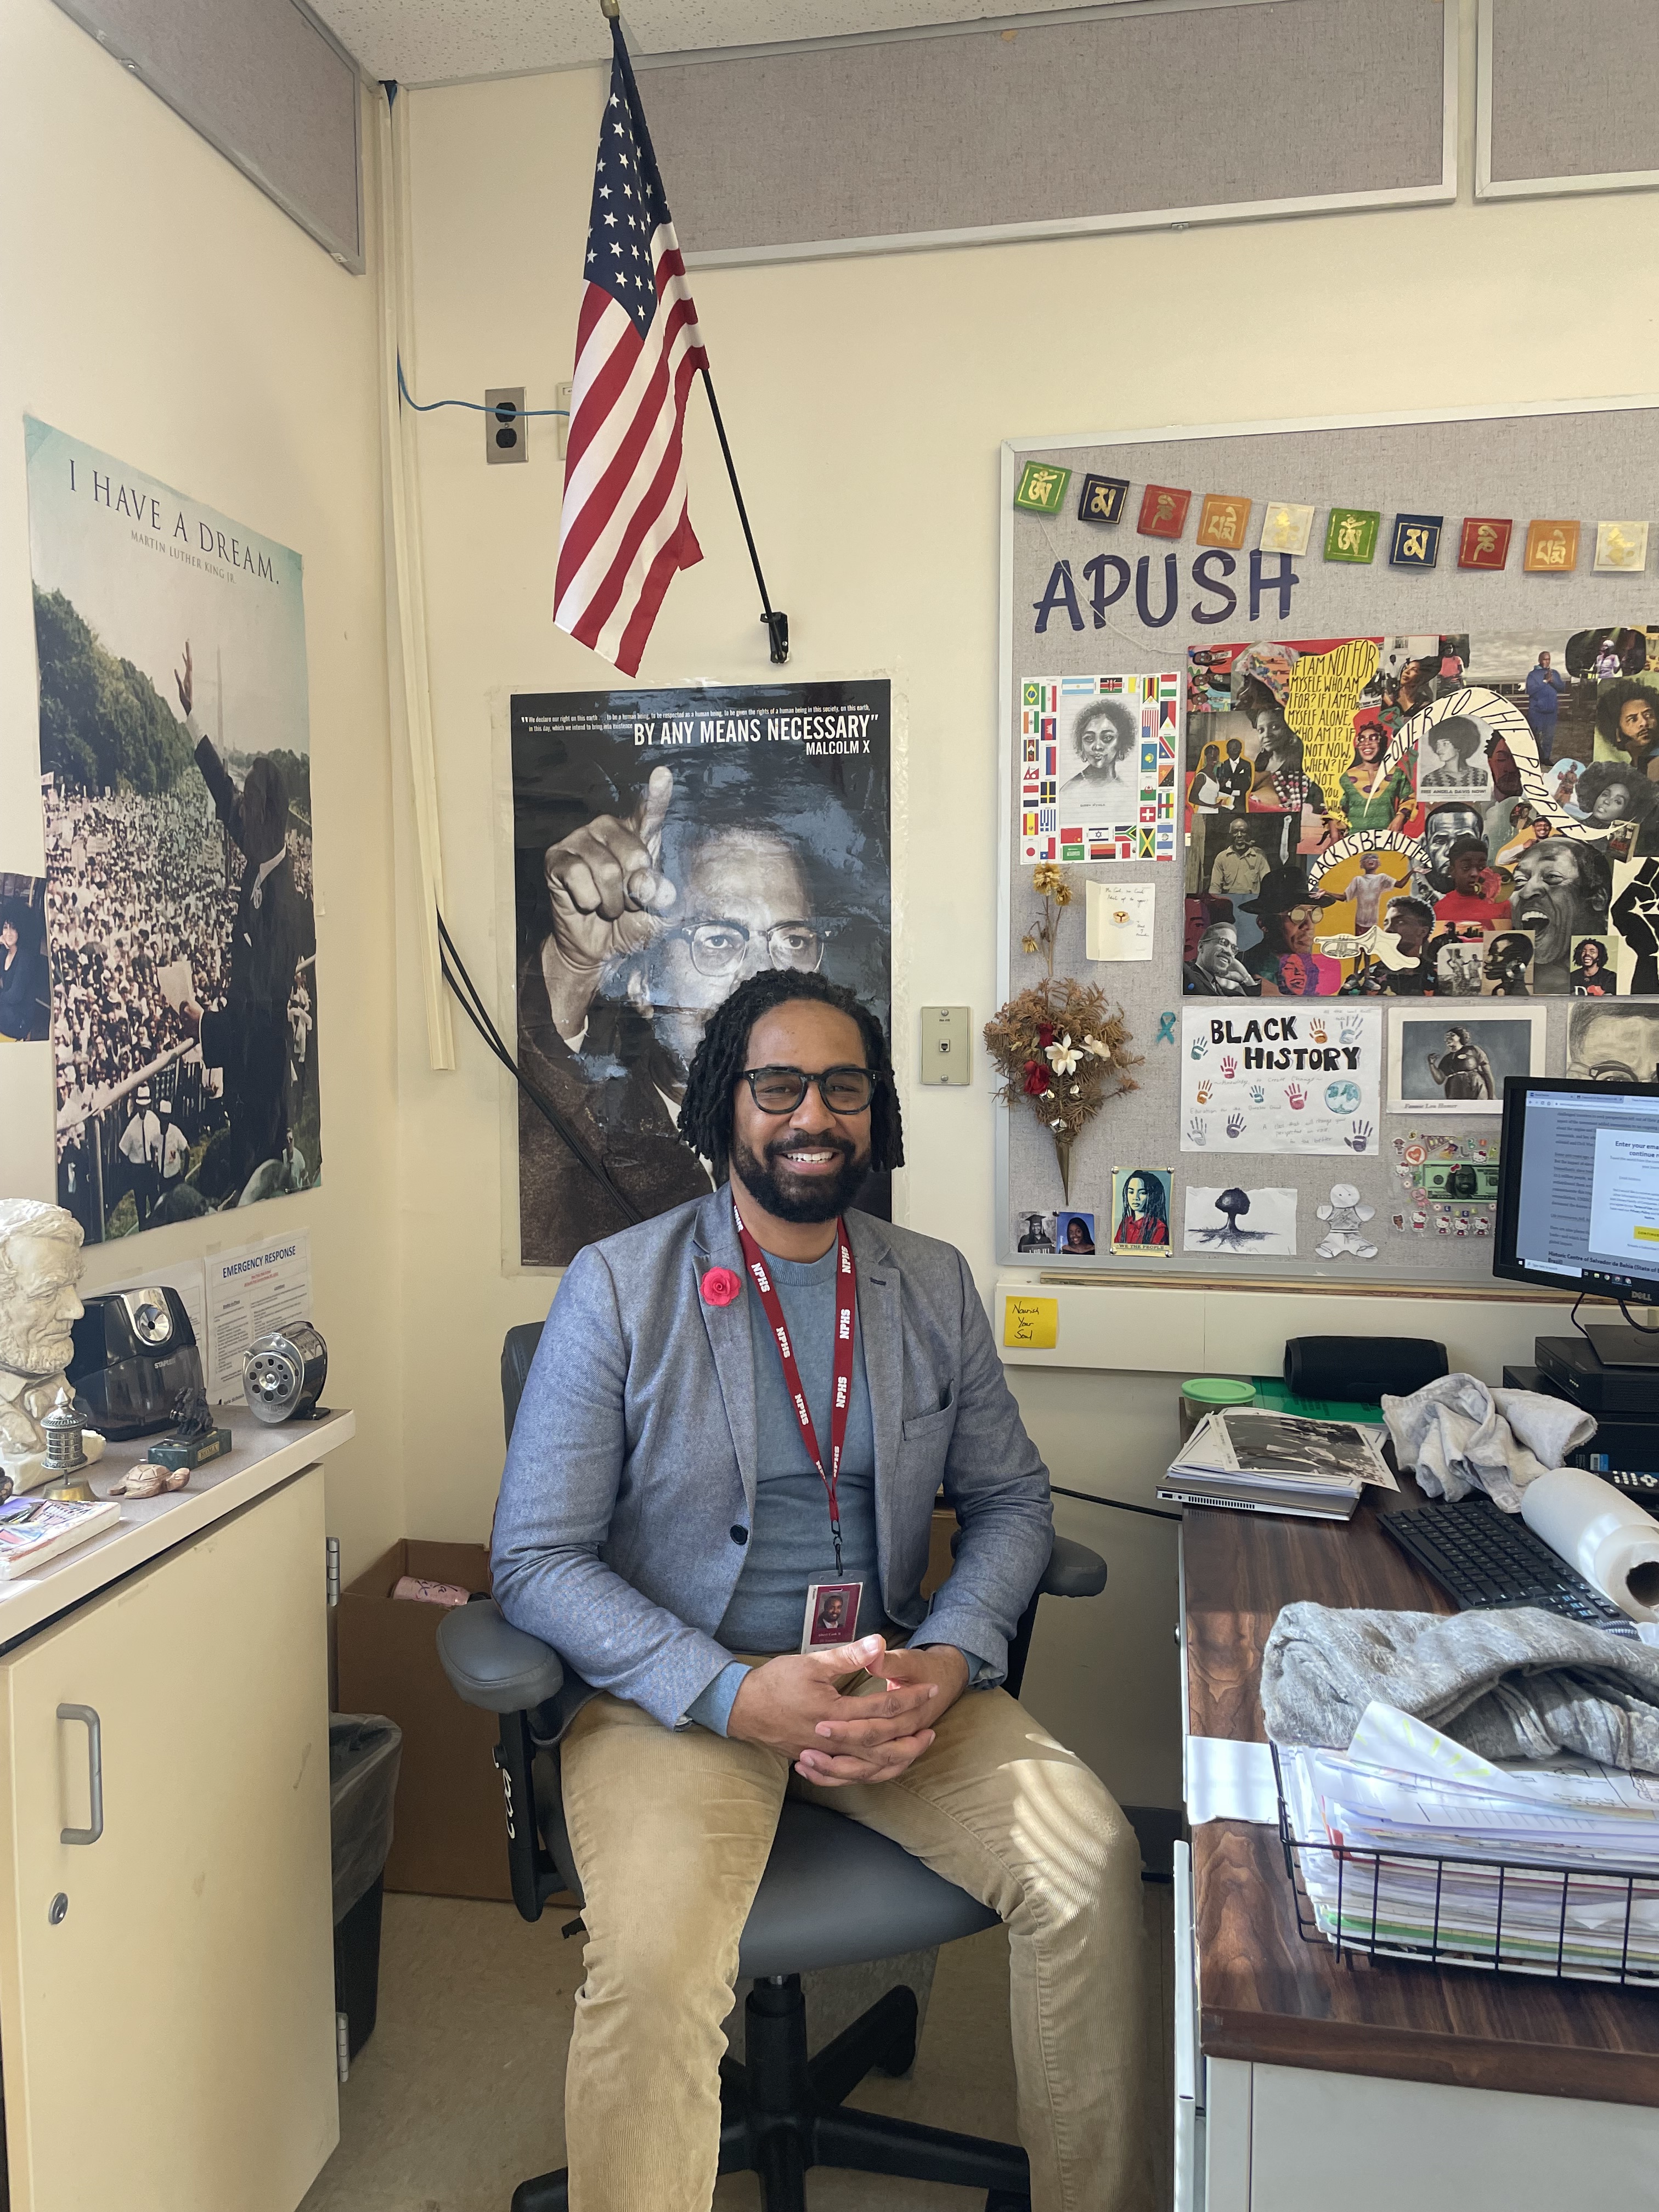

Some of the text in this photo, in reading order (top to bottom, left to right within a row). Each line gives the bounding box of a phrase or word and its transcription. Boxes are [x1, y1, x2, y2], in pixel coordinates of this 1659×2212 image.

[70, 459, 280, 585] I HAVE A DREAM.
[131, 529, 166, 554] MARTIN
[169, 548, 202, 569] LUTHER
[204, 562, 224, 579] KING
[1034, 550, 1300, 633] APUSH
[1291, 660, 1302, 676] IF
[1307, 656, 1326, 675] AM
[1327, 643, 1353, 676] NOT
[1351, 640, 1376, 678] FOR
[1324, 676, 1342, 693] WHO
[1344, 676, 1360, 693] AM
[1318, 693, 1327, 708] IF
[1332, 693, 1347, 709] AM
[634, 723, 655, 746] BY
[660, 721, 694, 745] ANY
[700, 718, 761, 743] MEANS
[1288, 709, 1351, 727] MYSELF ALONE,
[1294, 726, 1313, 742] WHO
[1314, 726, 1331, 742] AM
[1346, 727, 1356, 742] IF
[1381, 706, 1434, 776] POWER
[1438, 689, 1472, 723] TO
[1469, 691, 1535, 742] THE
[806, 740, 870, 755] MALCOLM X
[1305, 743, 1324, 758] NOT
[1304, 758, 1349, 774] WHEN? IF
[1313, 773, 1335, 786] NOT
[1308, 845, 1345, 887] BLACK
[1343, 834, 1358, 857] IS
[1210, 1015, 1299, 1045] BLACK
[1243, 1046, 1361, 1073] HISTORY
[223, 1256, 263, 1278] EMERGENCY
[264, 1245, 296, 1264] RESPONSE
[842, 1245, 851, 1274] NPHS
[751, 1262, 770, 1293] NPHS
[1012, 1301, 1039, 1315] Nourish
[1632, 1291, 1652, 1301] DELL
[840, 1308, 850, 1339] NPHS
[1014, 1329, 1032, 1340] Soul
[1018, 1317, 1034, 1328] Your
[776, 1327, 791, 1358] NPHS
[836, 1376, 847, 1408] NPHS
[794, 1393, 809, 1425] NPHS
